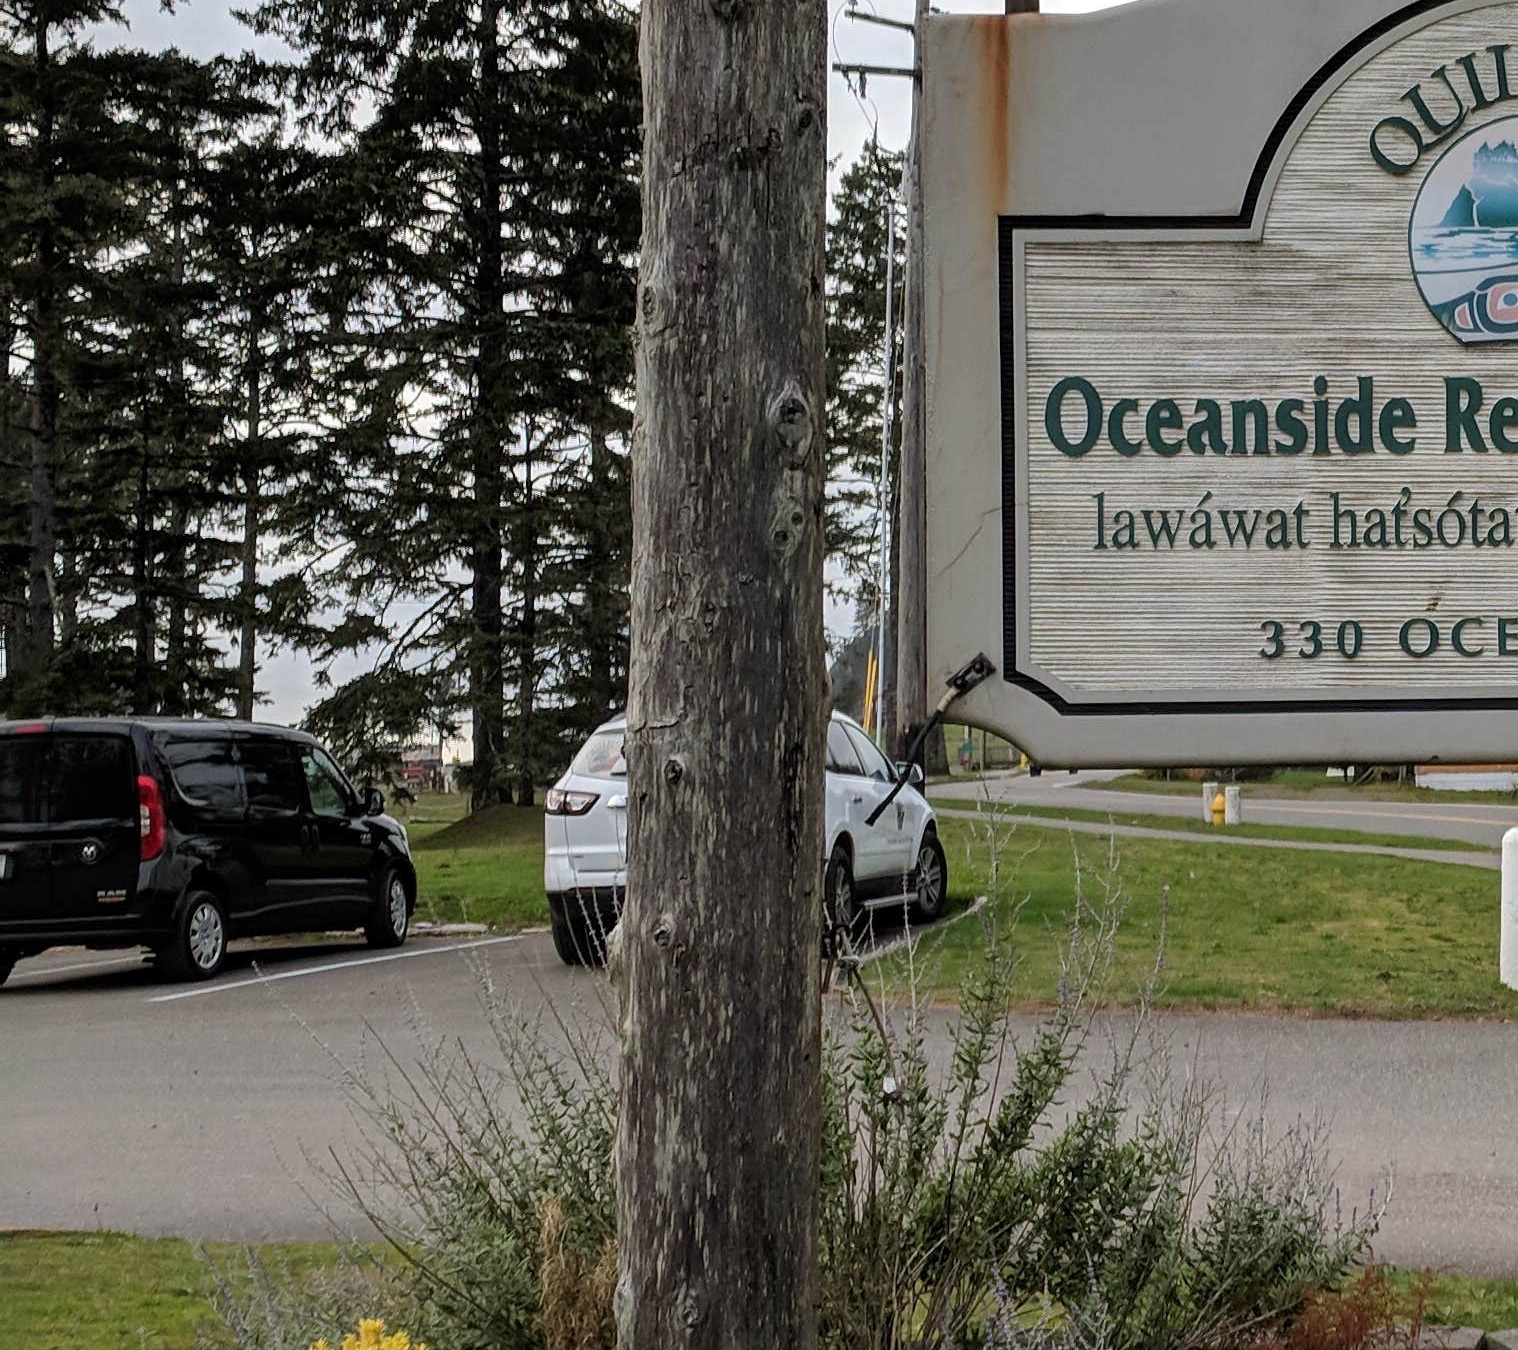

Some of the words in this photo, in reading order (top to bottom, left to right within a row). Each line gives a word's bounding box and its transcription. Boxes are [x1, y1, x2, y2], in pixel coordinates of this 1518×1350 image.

[1044, 375, 1417, 457] Oceanside
[1092, 491, 1310, 550] lawáwat
[1259, 620, 1364, 659] 330
